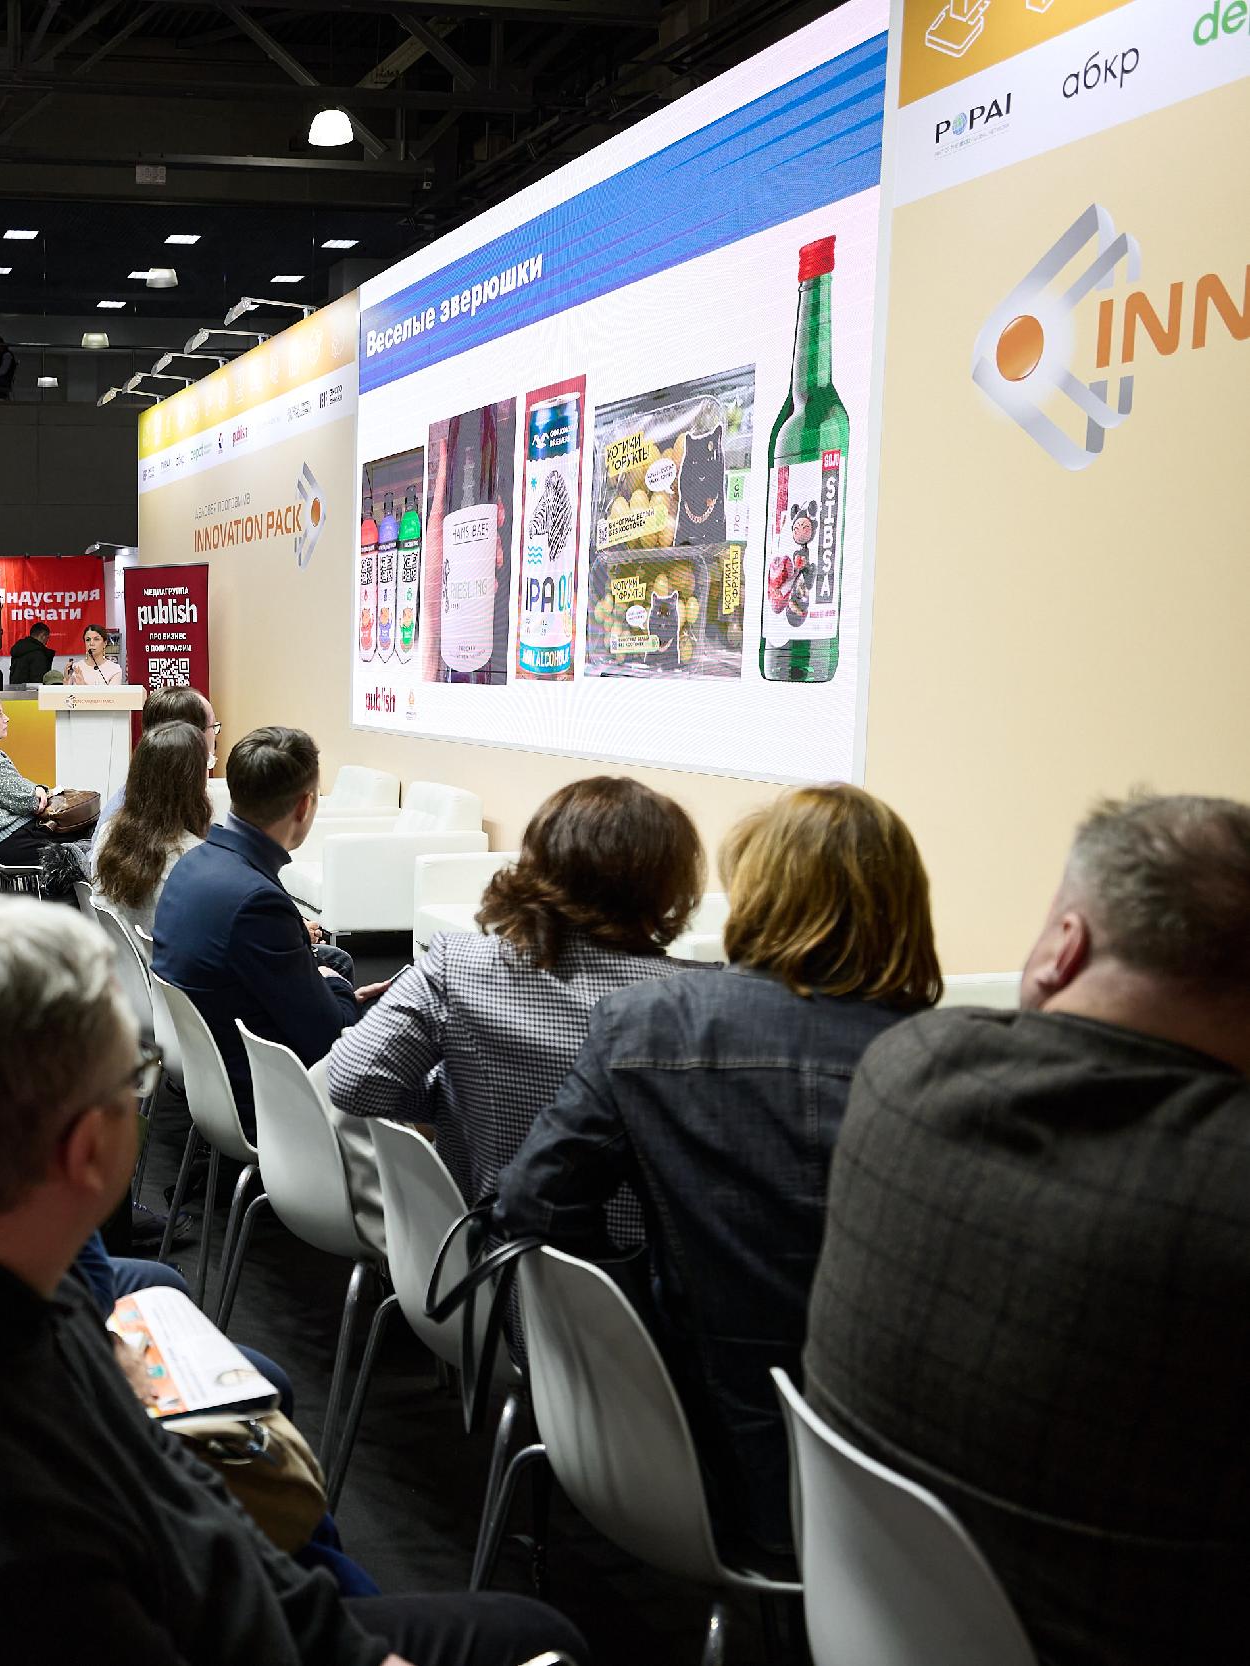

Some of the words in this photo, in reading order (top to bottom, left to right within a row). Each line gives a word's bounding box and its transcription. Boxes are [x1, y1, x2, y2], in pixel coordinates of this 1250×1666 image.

[1193, 0, 1250, 46] de
[1062, 47, 1140, 99] абкр
[366, 307, 436, 358] Веселые
[439, 254, 543, 323] зверюшки
[194, 513, 263, 553] INNOVATION
[266, 503, 302, 538] PACK
[11, 608, 82, 621] печати
[138, 598, 198, 631] publish
[525, 576, 555, 613] IPA
[150, 632, 161, 640] ПРО
[162, 632, 187, 640] БИЗНЕС
